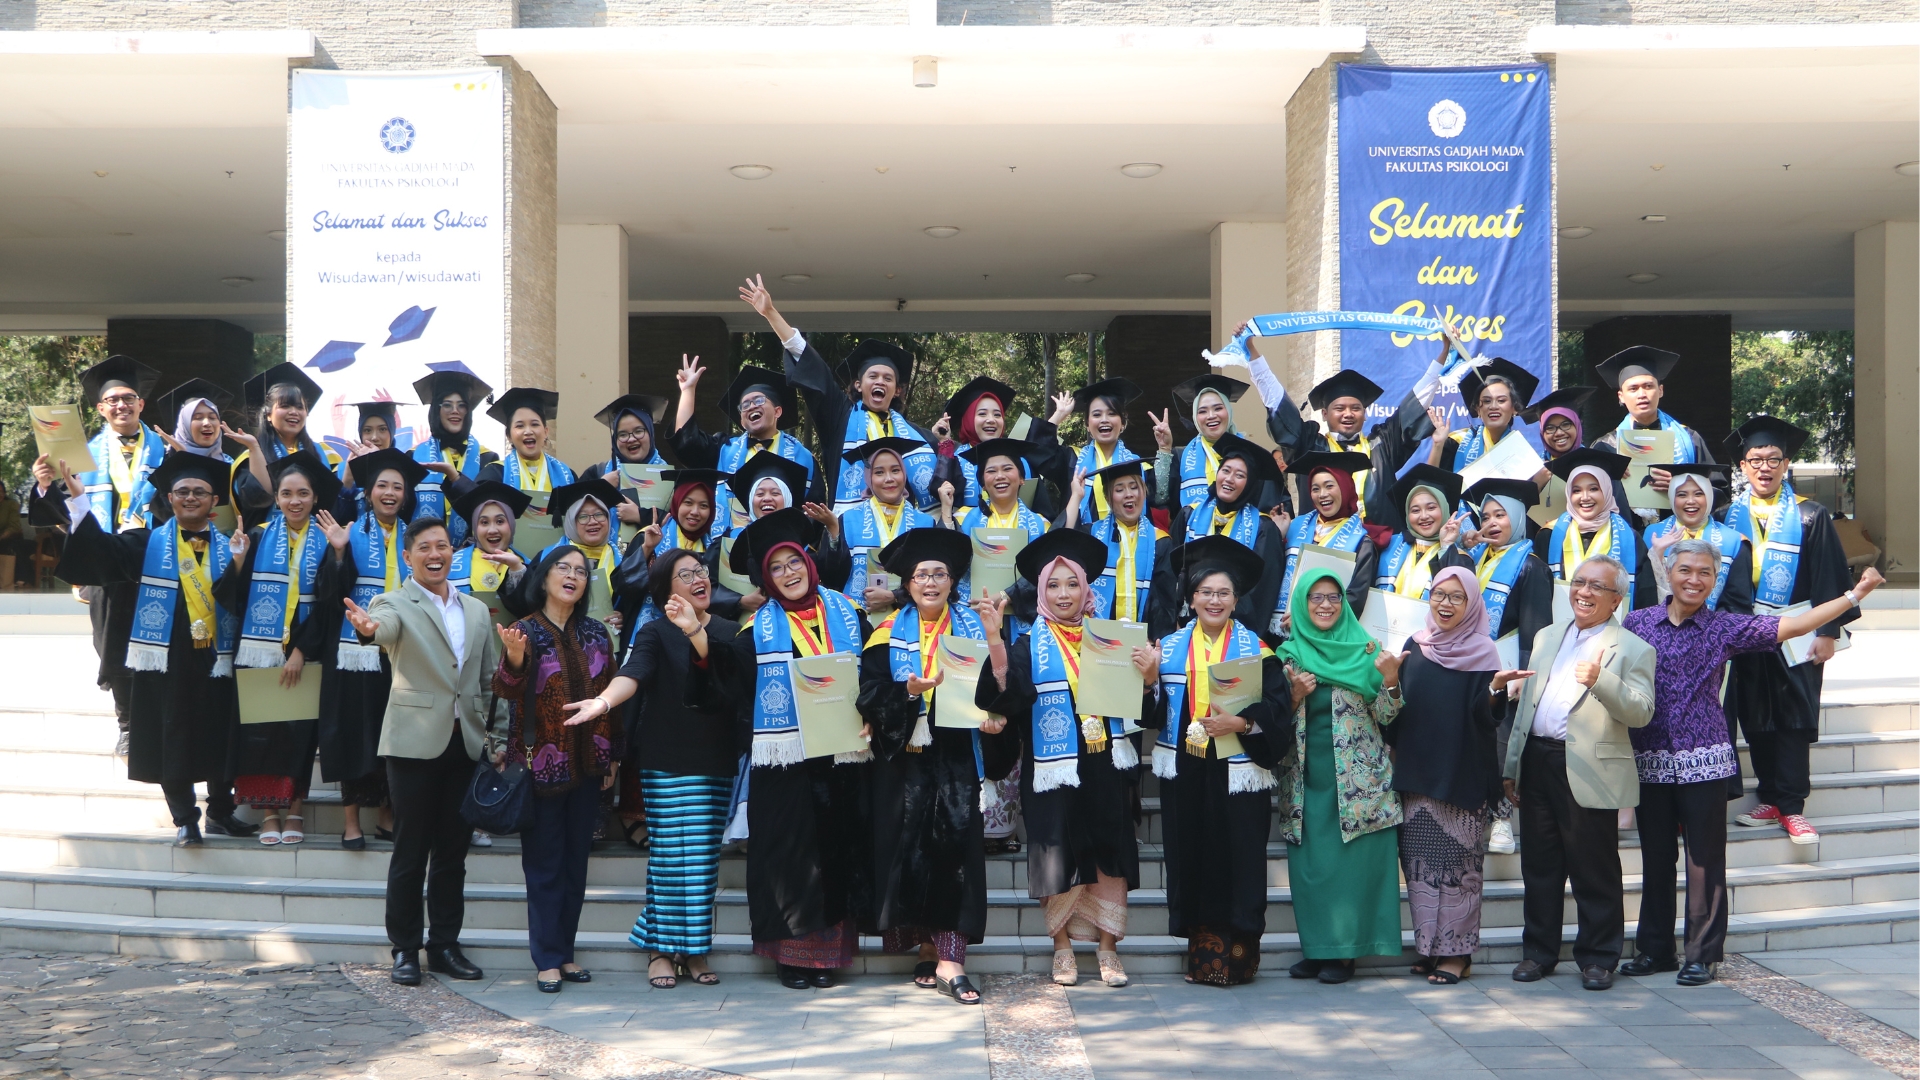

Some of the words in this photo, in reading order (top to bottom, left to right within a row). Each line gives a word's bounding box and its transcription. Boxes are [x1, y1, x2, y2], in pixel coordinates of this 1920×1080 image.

[1368, 146, 1441, 157] UNIVERSITAS
[1443, 146, 1489, 159] GADJAH
[1491, 146, 1525, 157] MADA
[394, 162, 438, 174] GADJAH
[442, 161, 475, 172] MADA
[1385, 161, 1443, 173] FAKULTAS
[1446, 161, 1509, 172] PSIKOLOGI
[338, 178, 394, 188] FAKULTAS
[397, 177, 459, 188] PSIKOLOGI
[312, 209, 386, 232] Selamat
[391, 212, 427, 229] dan
[433, 209, 488, 231] Sukses
[1368, 197, 1526, 246] Selamat
[376, 251, 421, 265] kepada
[1417, 255, 1479, 286] dan
[318, 271, 481, 285] Wisudawan/wisudawati
[1266, 313, 1355, 330] UNIVERSITAS
[1356, 314, 1408, 326] GADJAH
[909, 455, 932, 467] 1965
[419, 493, 437, 502] 965
[1186, 487, 1209, 498] 1965
[1767, 551, 1792, 563] 1965
[305, 549, 318, 586] MADA
[145, 587, 168, 599] 1965
[256, 583, 281, 594] 1965
[355, 587, 378, 597] 1965
[1488, 593, 1507, 605] 196
[763, 666, 785, 677] 1965
[1039, 694, 1066, 706] 1965
